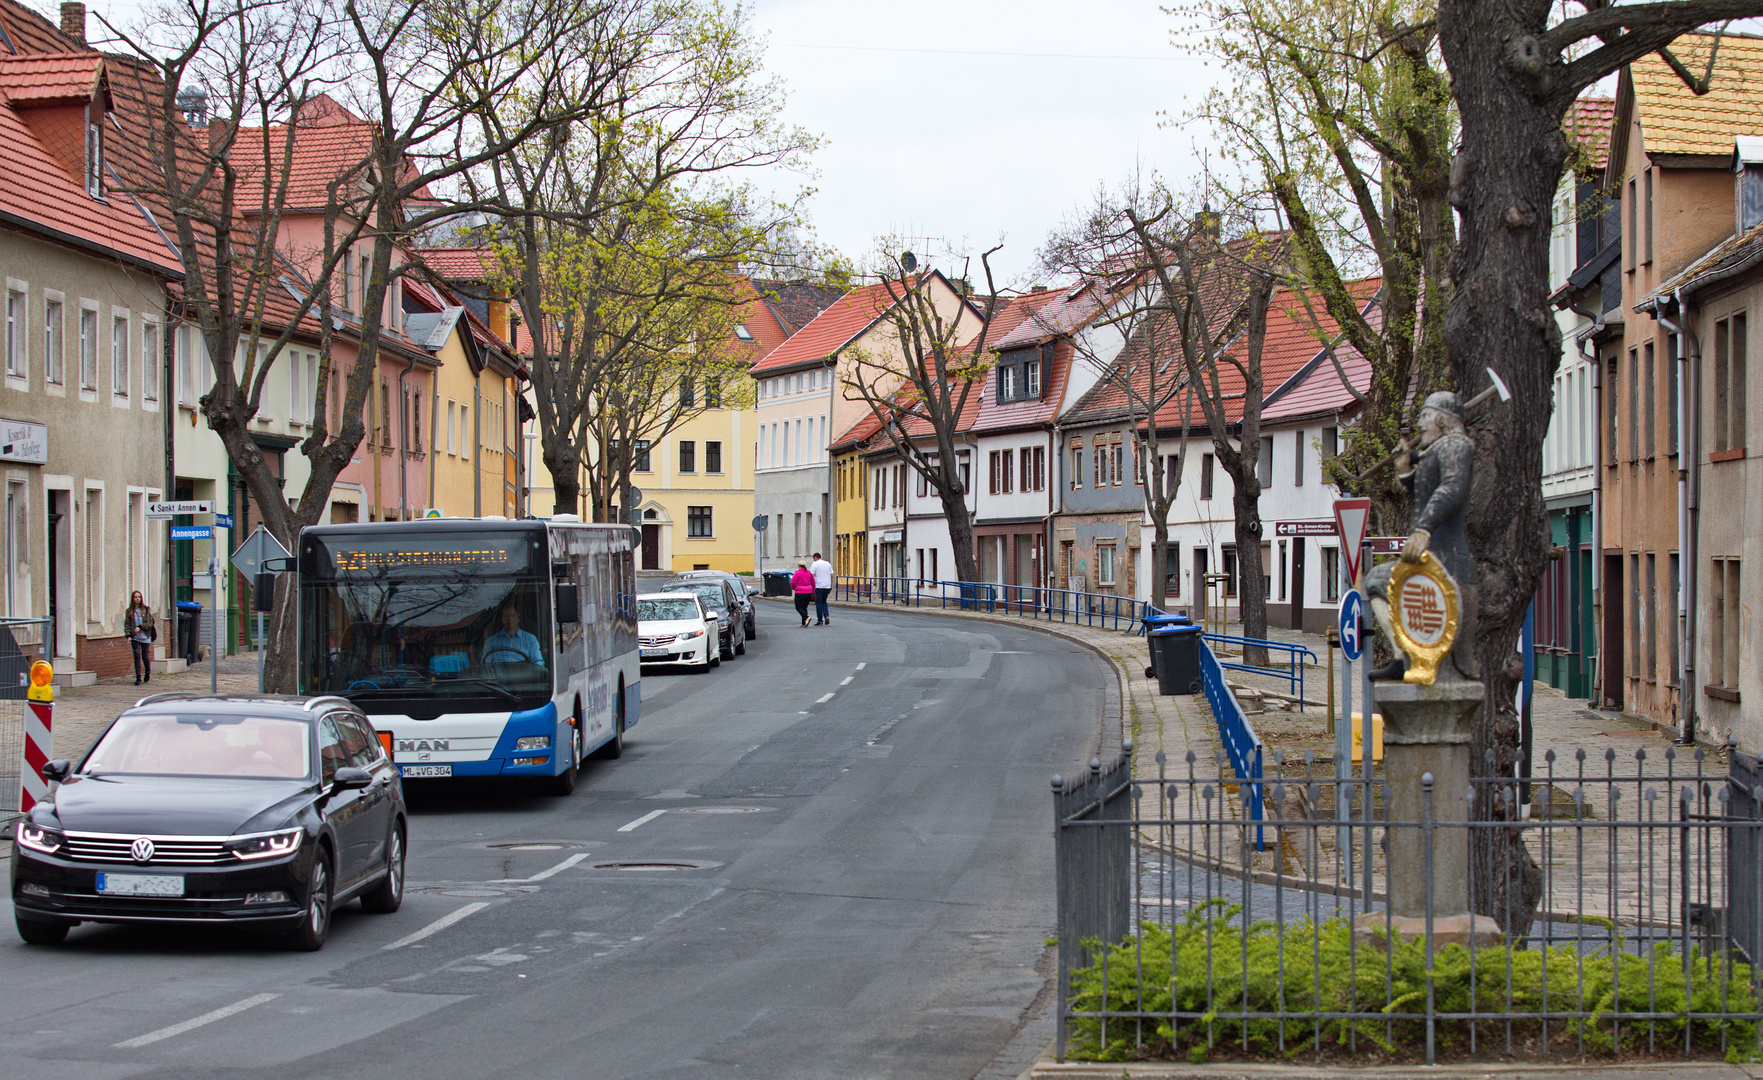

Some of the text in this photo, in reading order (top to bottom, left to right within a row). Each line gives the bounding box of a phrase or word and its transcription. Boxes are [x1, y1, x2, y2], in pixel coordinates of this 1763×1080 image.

[157, 503, 197, 512] Sankt Annen
[172, 529, 210, 539] Annengasse
[336, 550, 367, 570] 421
[399, 740, 449, 751] MAN
[421, 766, 432, 775] VG
[434, 766, 451, 775] 304
